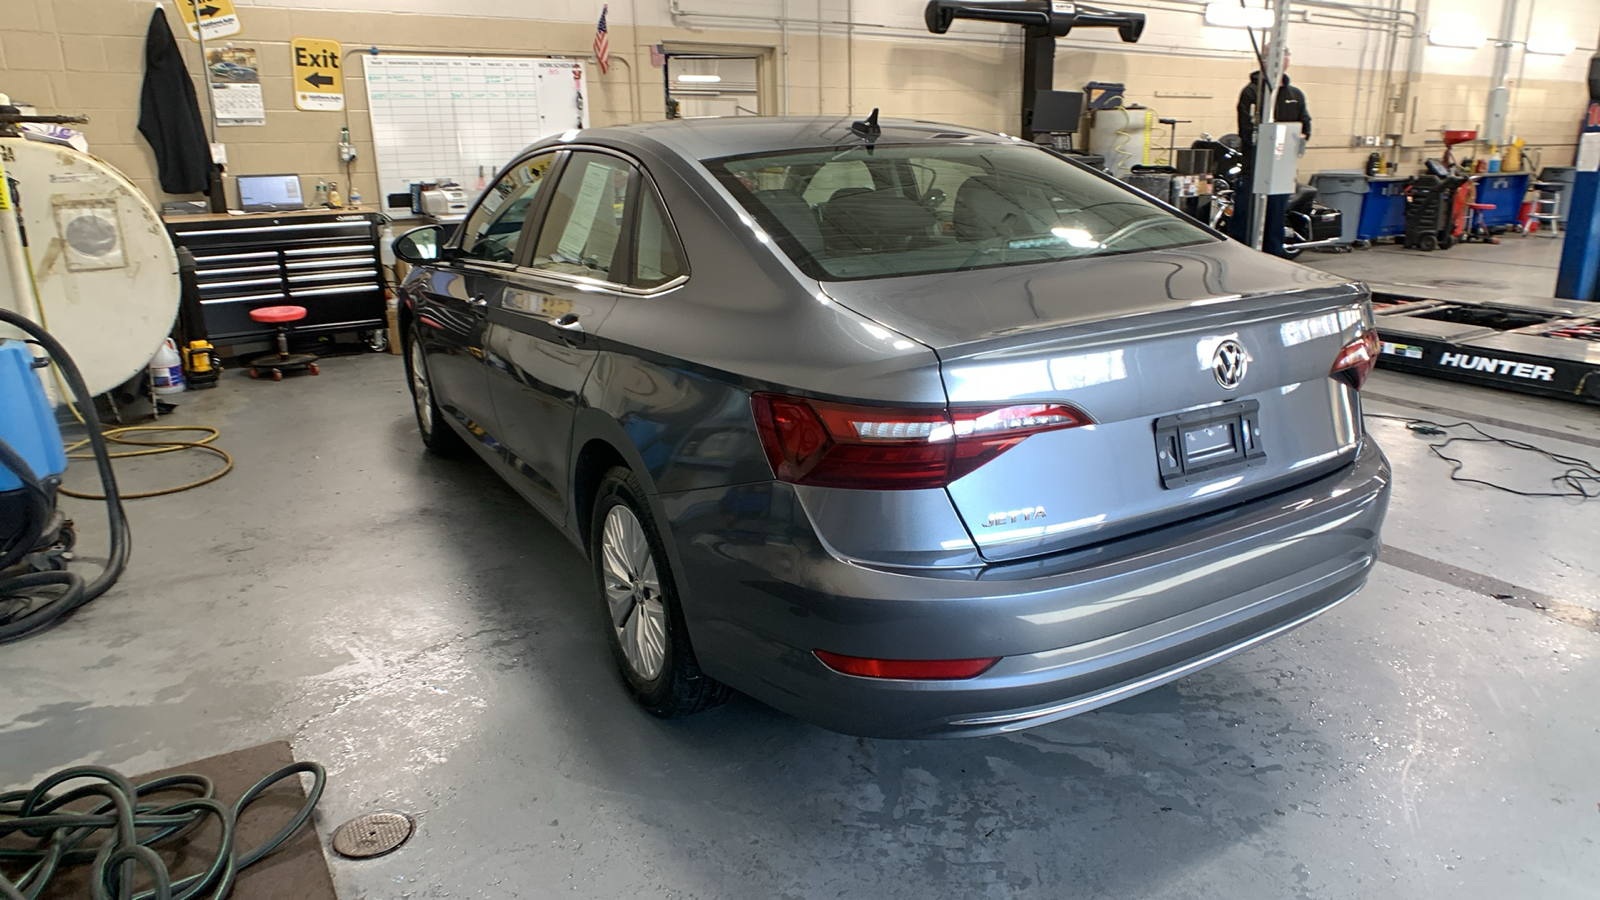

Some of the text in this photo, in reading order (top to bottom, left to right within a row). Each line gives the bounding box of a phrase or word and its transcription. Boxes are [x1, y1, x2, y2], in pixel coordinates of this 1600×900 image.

[295, 46, 339, 69] Exit
[1439, 351, 1555, 381] HUNTER
[981, 506, 1046, 528] JETTA
